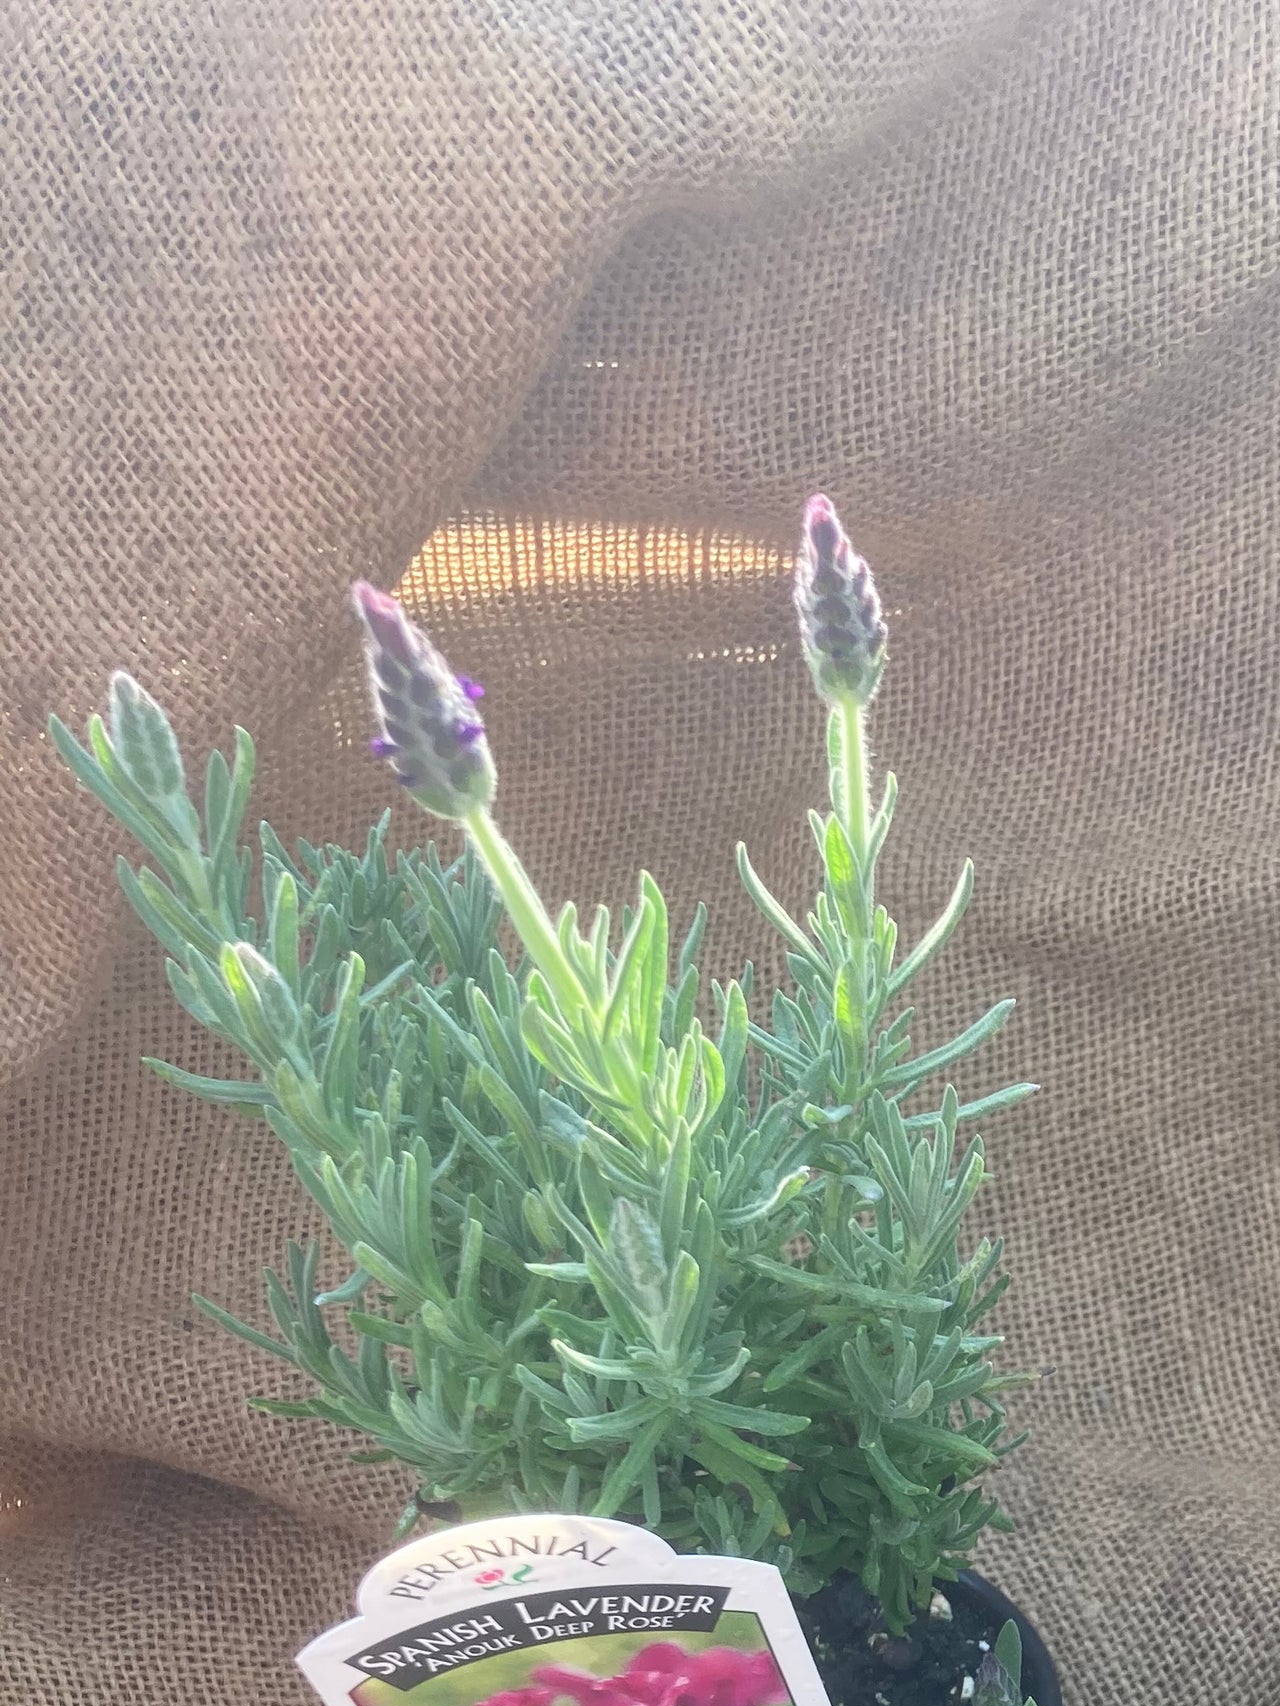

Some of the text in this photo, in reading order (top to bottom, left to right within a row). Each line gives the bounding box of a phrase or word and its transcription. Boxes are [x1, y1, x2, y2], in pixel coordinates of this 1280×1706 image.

[390, 1534, 618, 1601] PERENNIAL
[358, 1595, 715, 1677] SPANISH LAVENDER
[531, 1620, 595, 1642] DEEP
